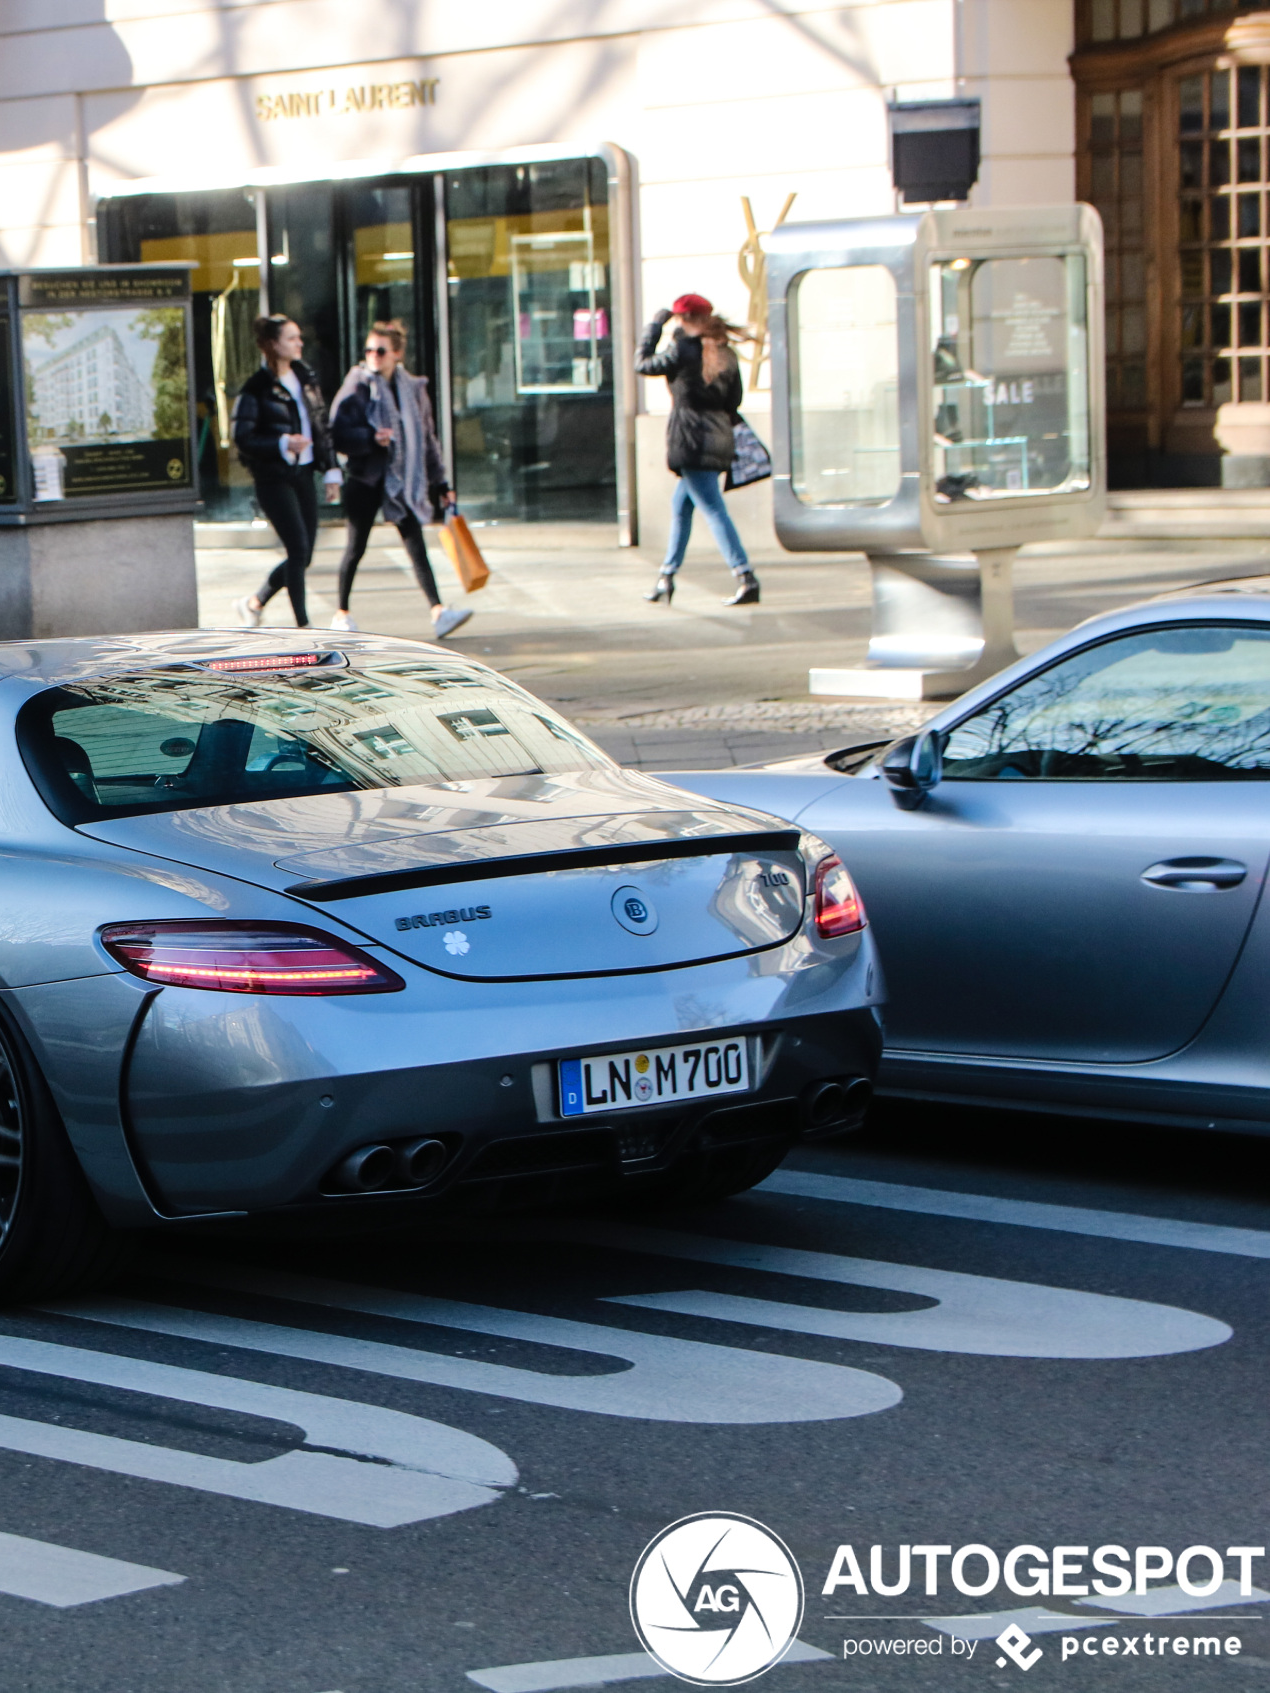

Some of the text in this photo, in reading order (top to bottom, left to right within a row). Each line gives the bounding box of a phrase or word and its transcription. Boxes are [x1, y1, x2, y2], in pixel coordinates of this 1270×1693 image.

[256, 78, 439, 121] SAINT LAURENT
[982, 380, 1034, 406] SALE
[759, 872, 790, 887] 700
[394, 905, 492, 931] BRABUS
[568, 1043, 742, 1105] D LN M 700
